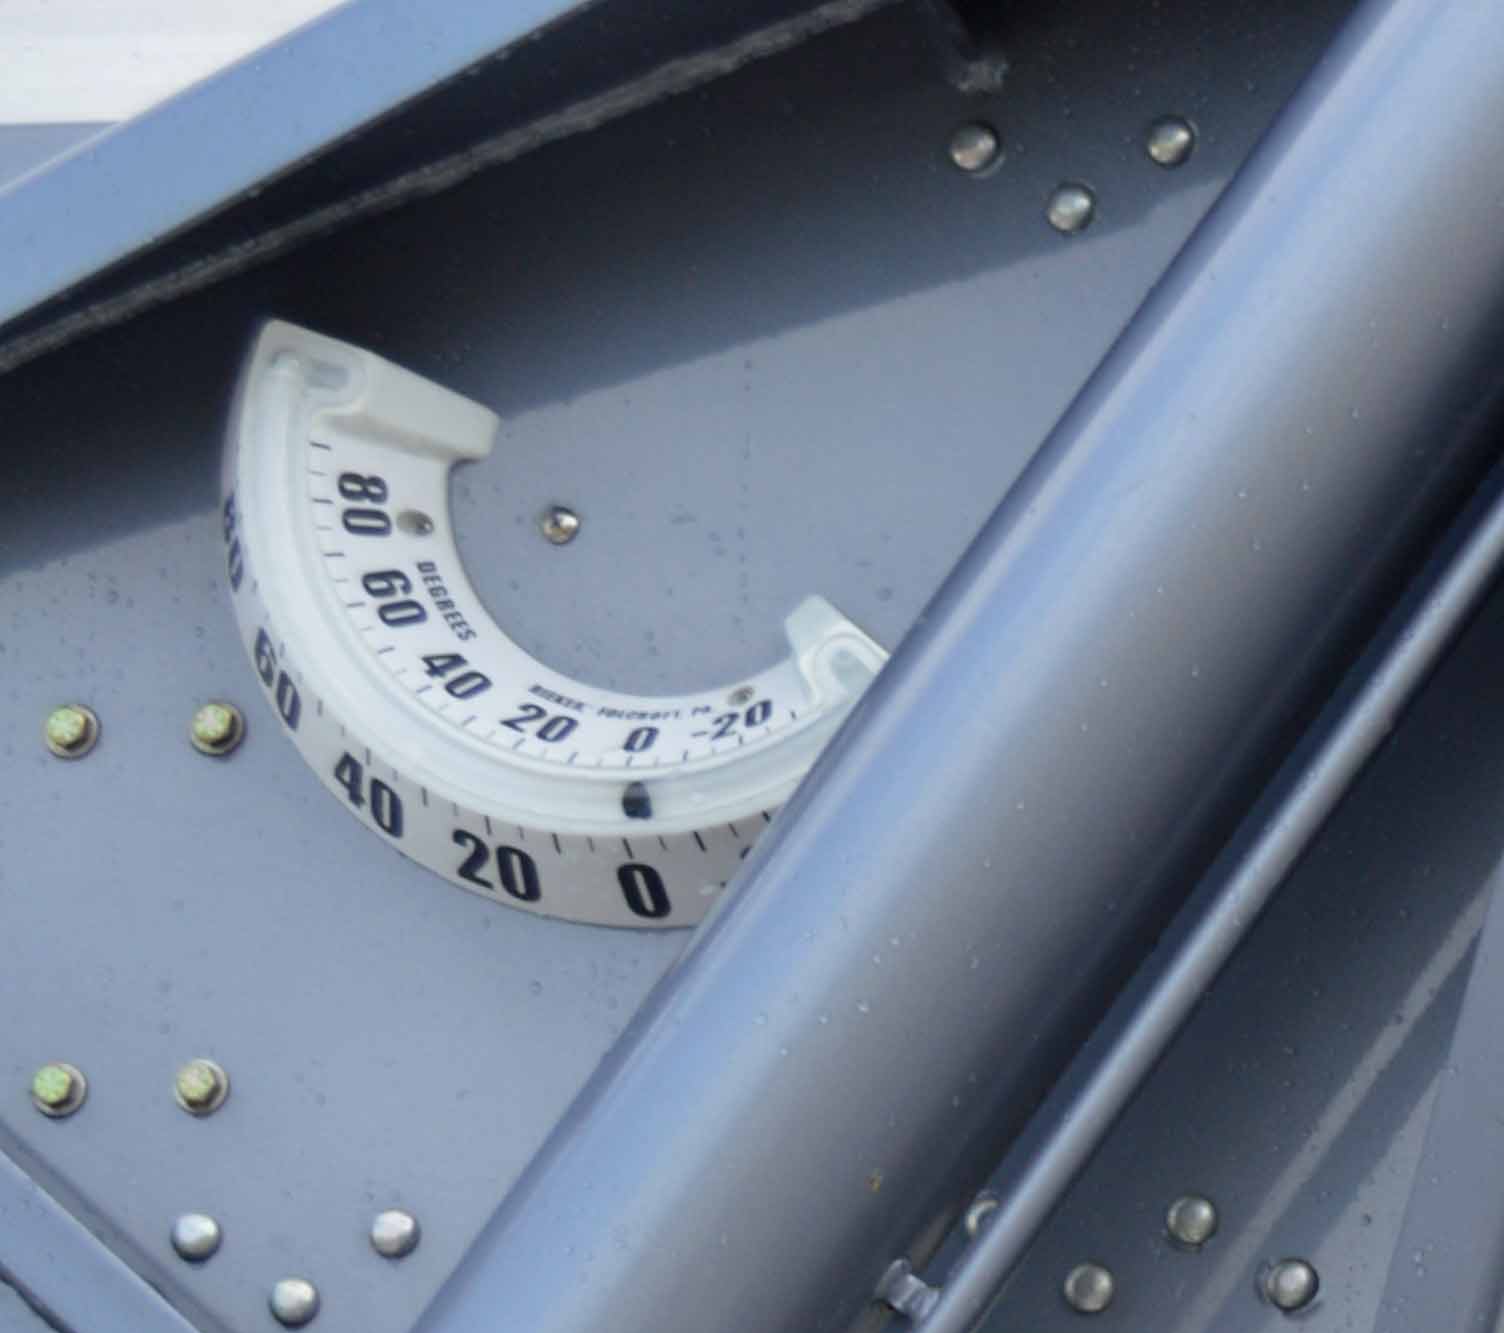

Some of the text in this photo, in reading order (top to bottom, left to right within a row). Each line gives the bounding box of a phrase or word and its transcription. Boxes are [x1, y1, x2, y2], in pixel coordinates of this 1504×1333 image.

[361, 569, 428, 628] 60
[415, 560, 479, 642] DEGREES
[420, 651, 493, 702] 40
[500, 703, 579, 743] 20
[623, 726, 660, 753] 0
[333, 751, 405, 841] 40
[451, 829, 543, 903] 20
[616, 863, 672, 920] 0
